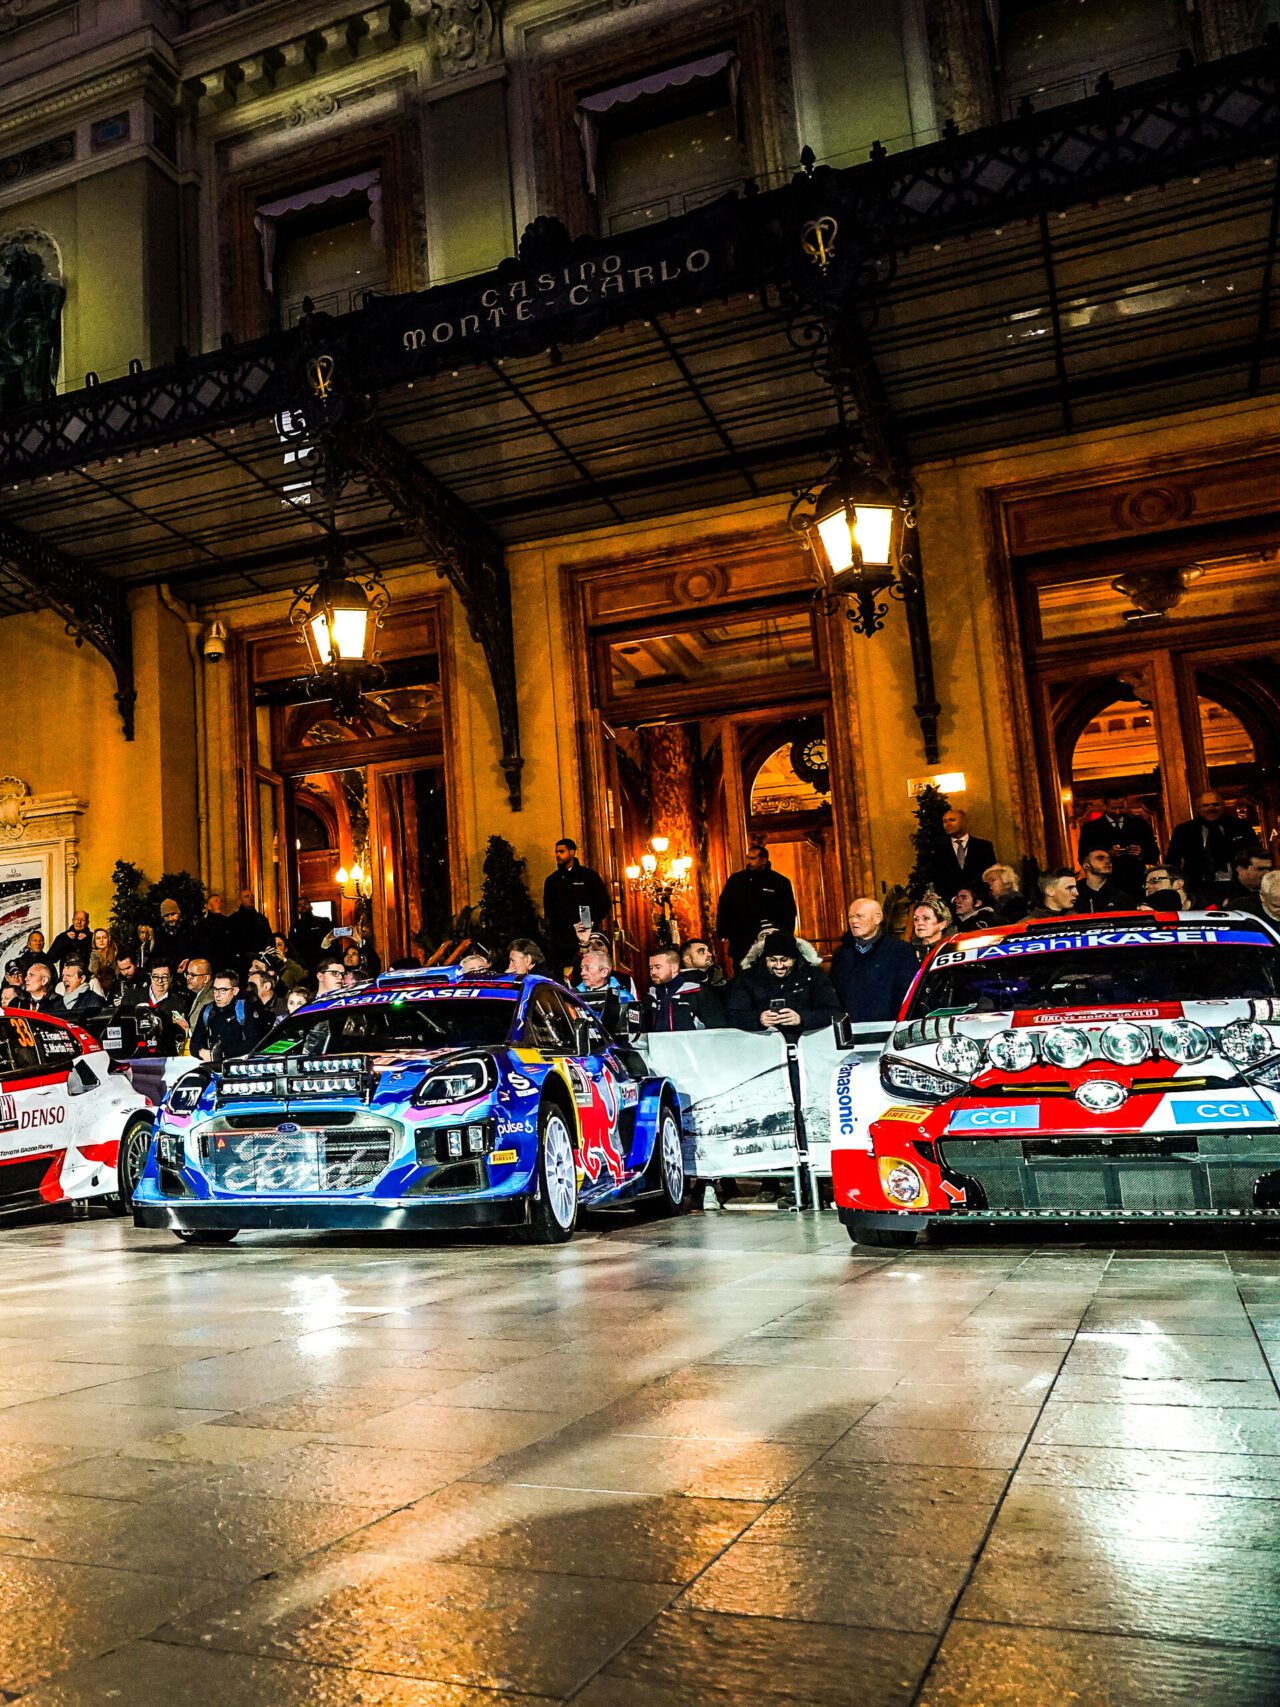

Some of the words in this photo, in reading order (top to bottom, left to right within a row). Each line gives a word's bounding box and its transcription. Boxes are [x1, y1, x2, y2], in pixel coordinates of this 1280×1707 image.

[481, 254, 621, 307] CASINO
[403, 248, 711, 351] MONTE-CARLO
[1085, 925, 1157, 935] GAZOO
[935, 951, 966, 967] 69
[10, 1017, 35, 1047] 33
[836, 1062, 860, 1135] Panasonic
[21, 1105, 65, 1130] DENSO
[496, 1120, 524, 1136] pulse
[0, 1148, 20, 1157] TOYOTA
